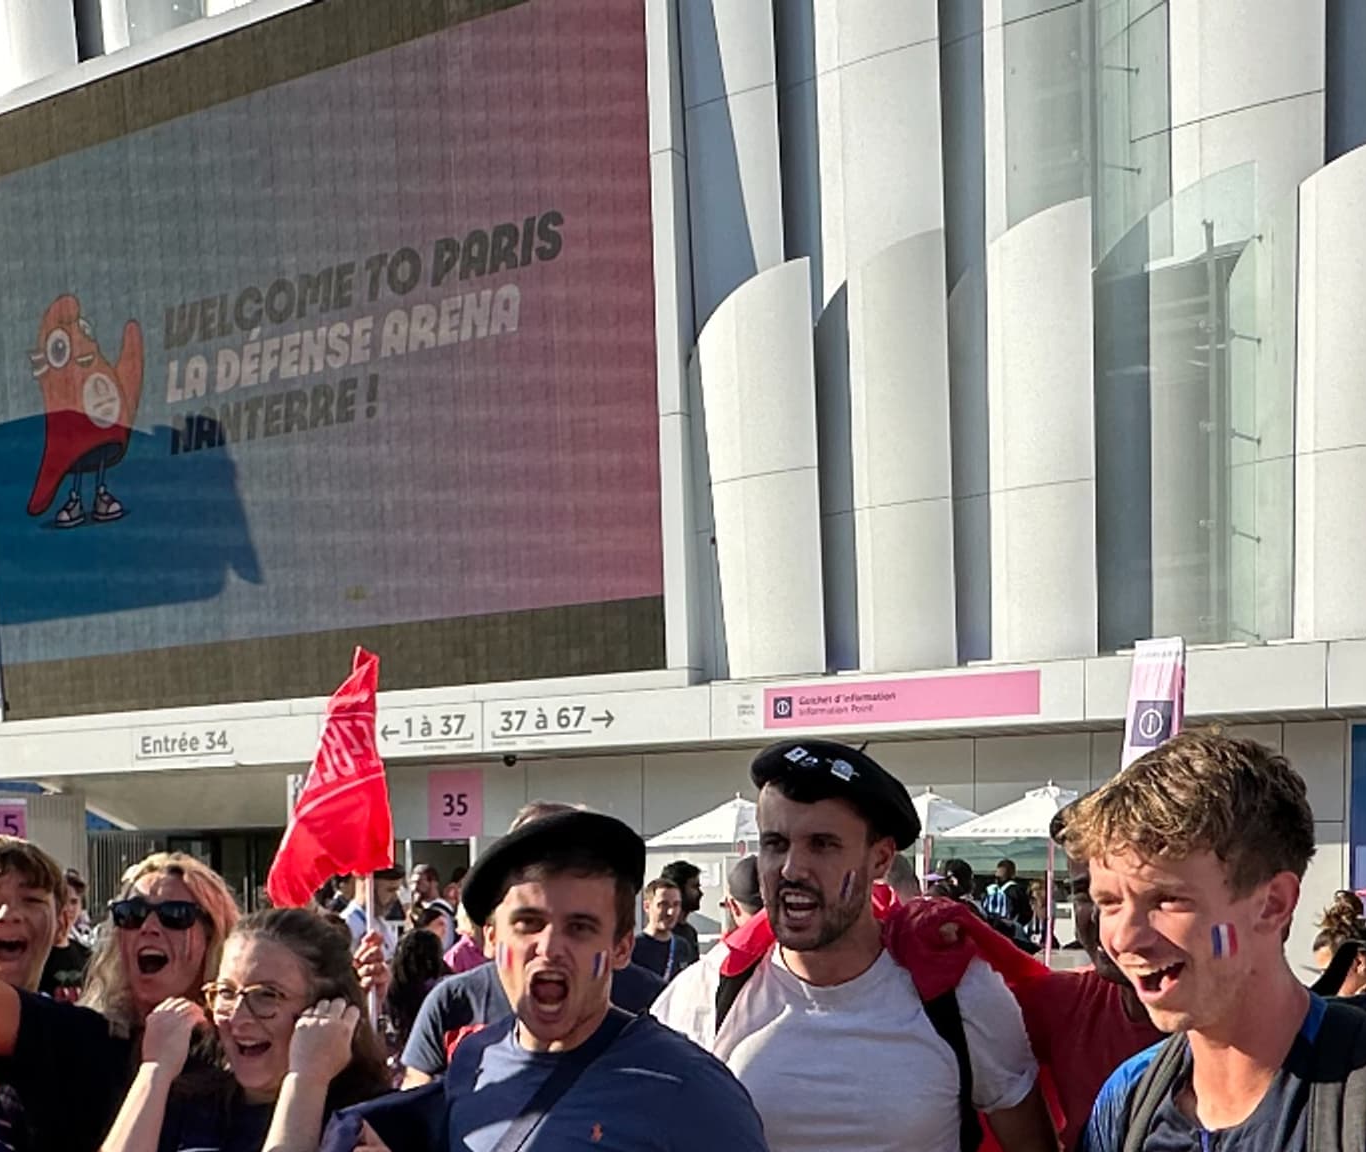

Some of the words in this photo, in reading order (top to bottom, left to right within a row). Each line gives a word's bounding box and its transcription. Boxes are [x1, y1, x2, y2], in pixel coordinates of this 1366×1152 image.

[163, 261, 355, 350] WELCOME
[365, 247, 422, 295] TO
[432, 211, 564, 288] PARIS
[166, 358, 208, 404] LA
[216, 316, 372, 395] DÉFENSE
[380, 283, 522, 356] ARENA
[171, 378, 361, 456] NANTERRE
[499, 710, 527, 732] 37
[535, 708, 548, 730] à
[556, 706, 586, 729] 67
[851, 704, 874, 714] Point
[404, 717, 413, 738] 1
[420, 715, 432, 737] à
[439, 714, 466, 736] 37
[141, 732, 200, 754] Entrée
[205, 730, 228, 750] 34
[443, 793, 468, 817] 35
